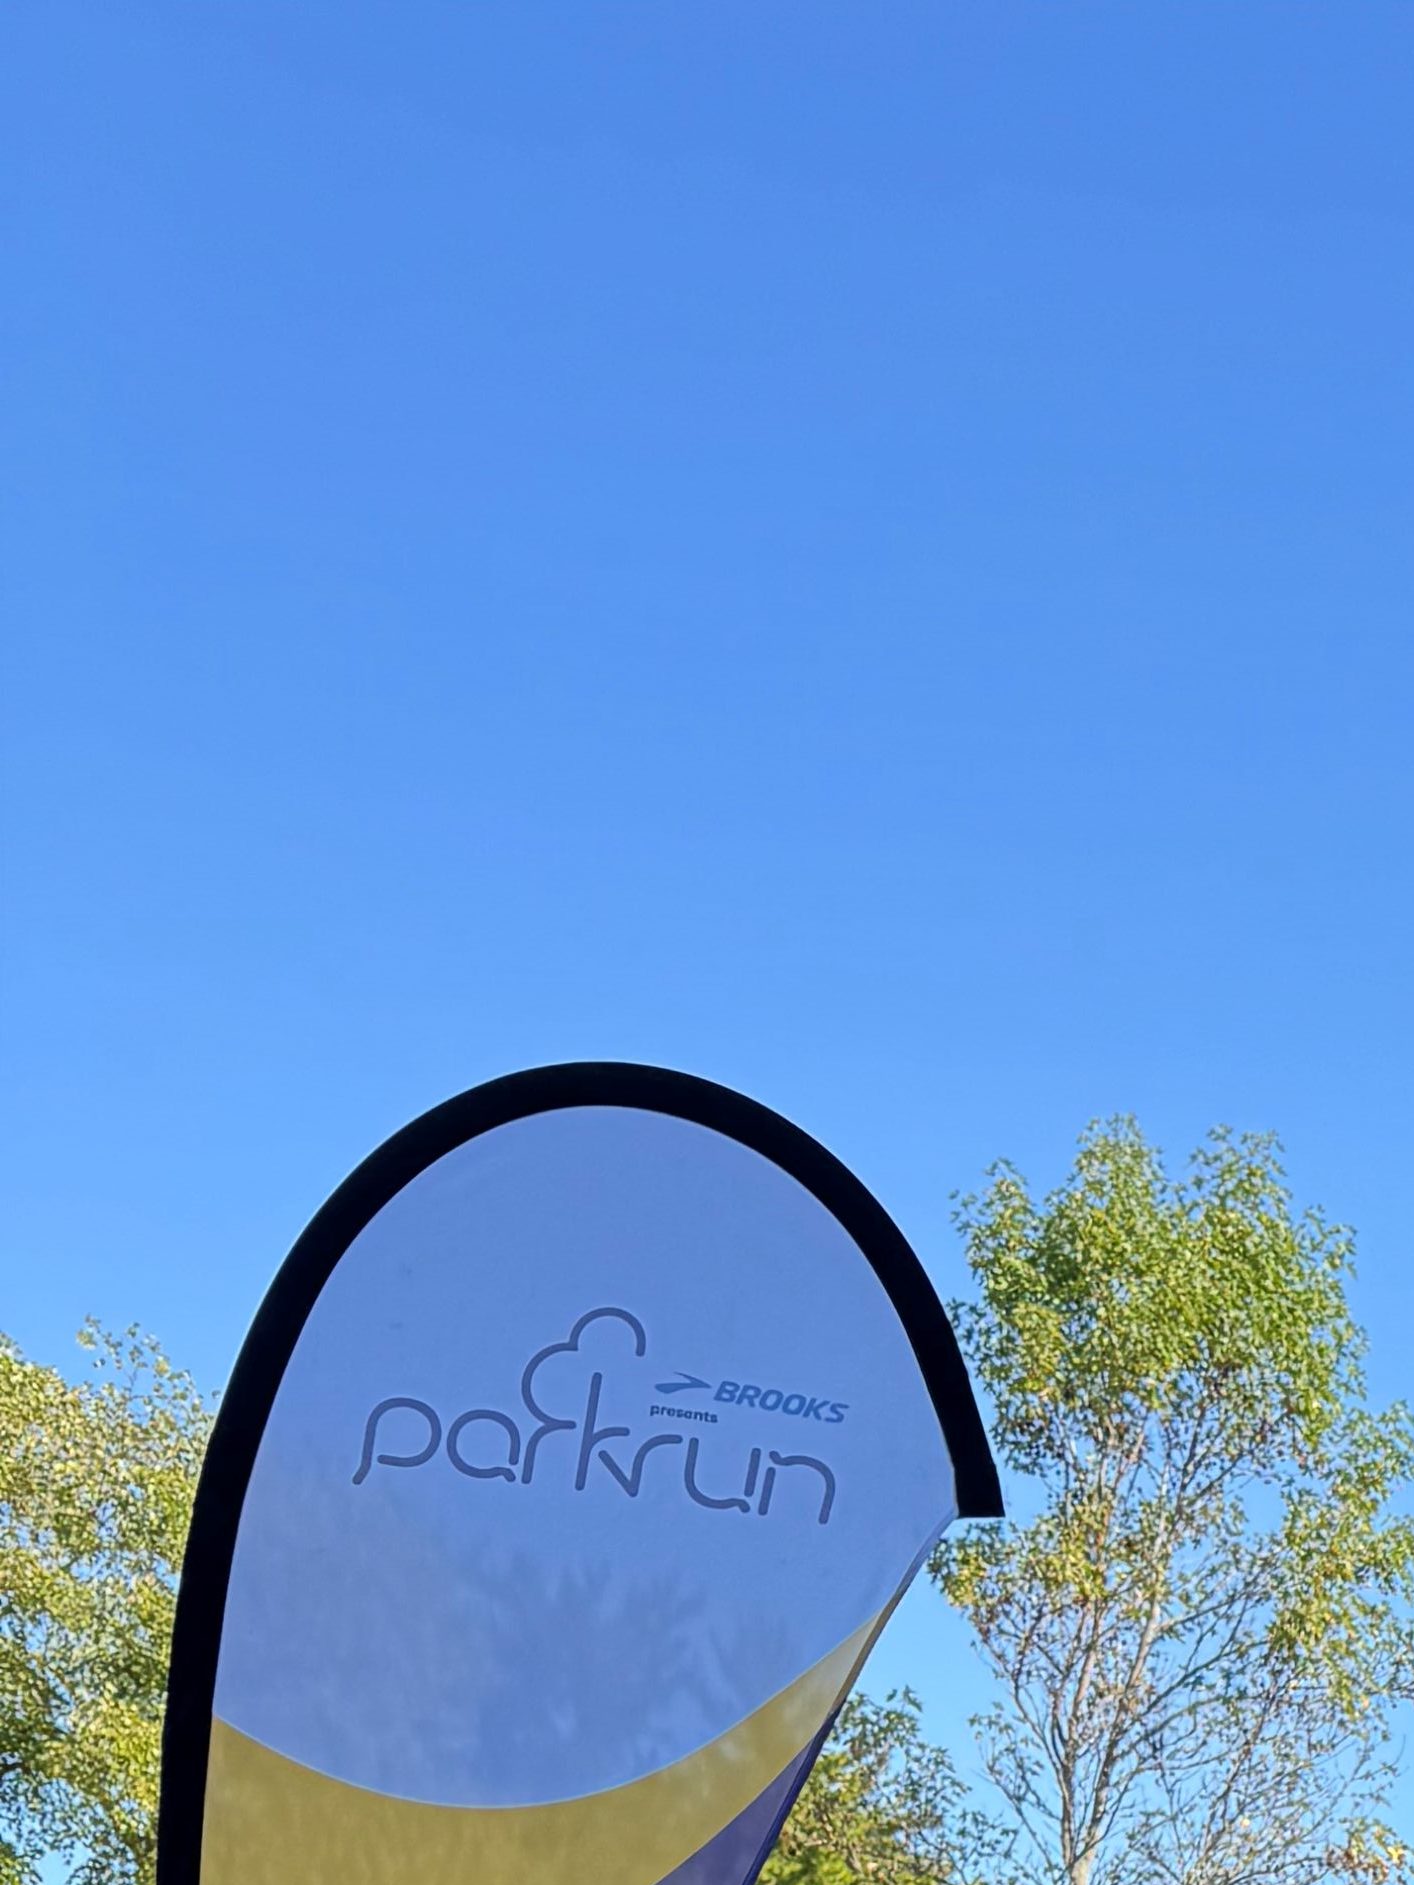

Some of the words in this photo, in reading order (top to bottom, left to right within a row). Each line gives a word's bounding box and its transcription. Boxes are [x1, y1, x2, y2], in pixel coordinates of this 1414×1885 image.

[650, 1405, 718, 1423] presents
[713, 1381, 849, 1423] BROOKS
[353, 1370, 836, 1525] parkrun
